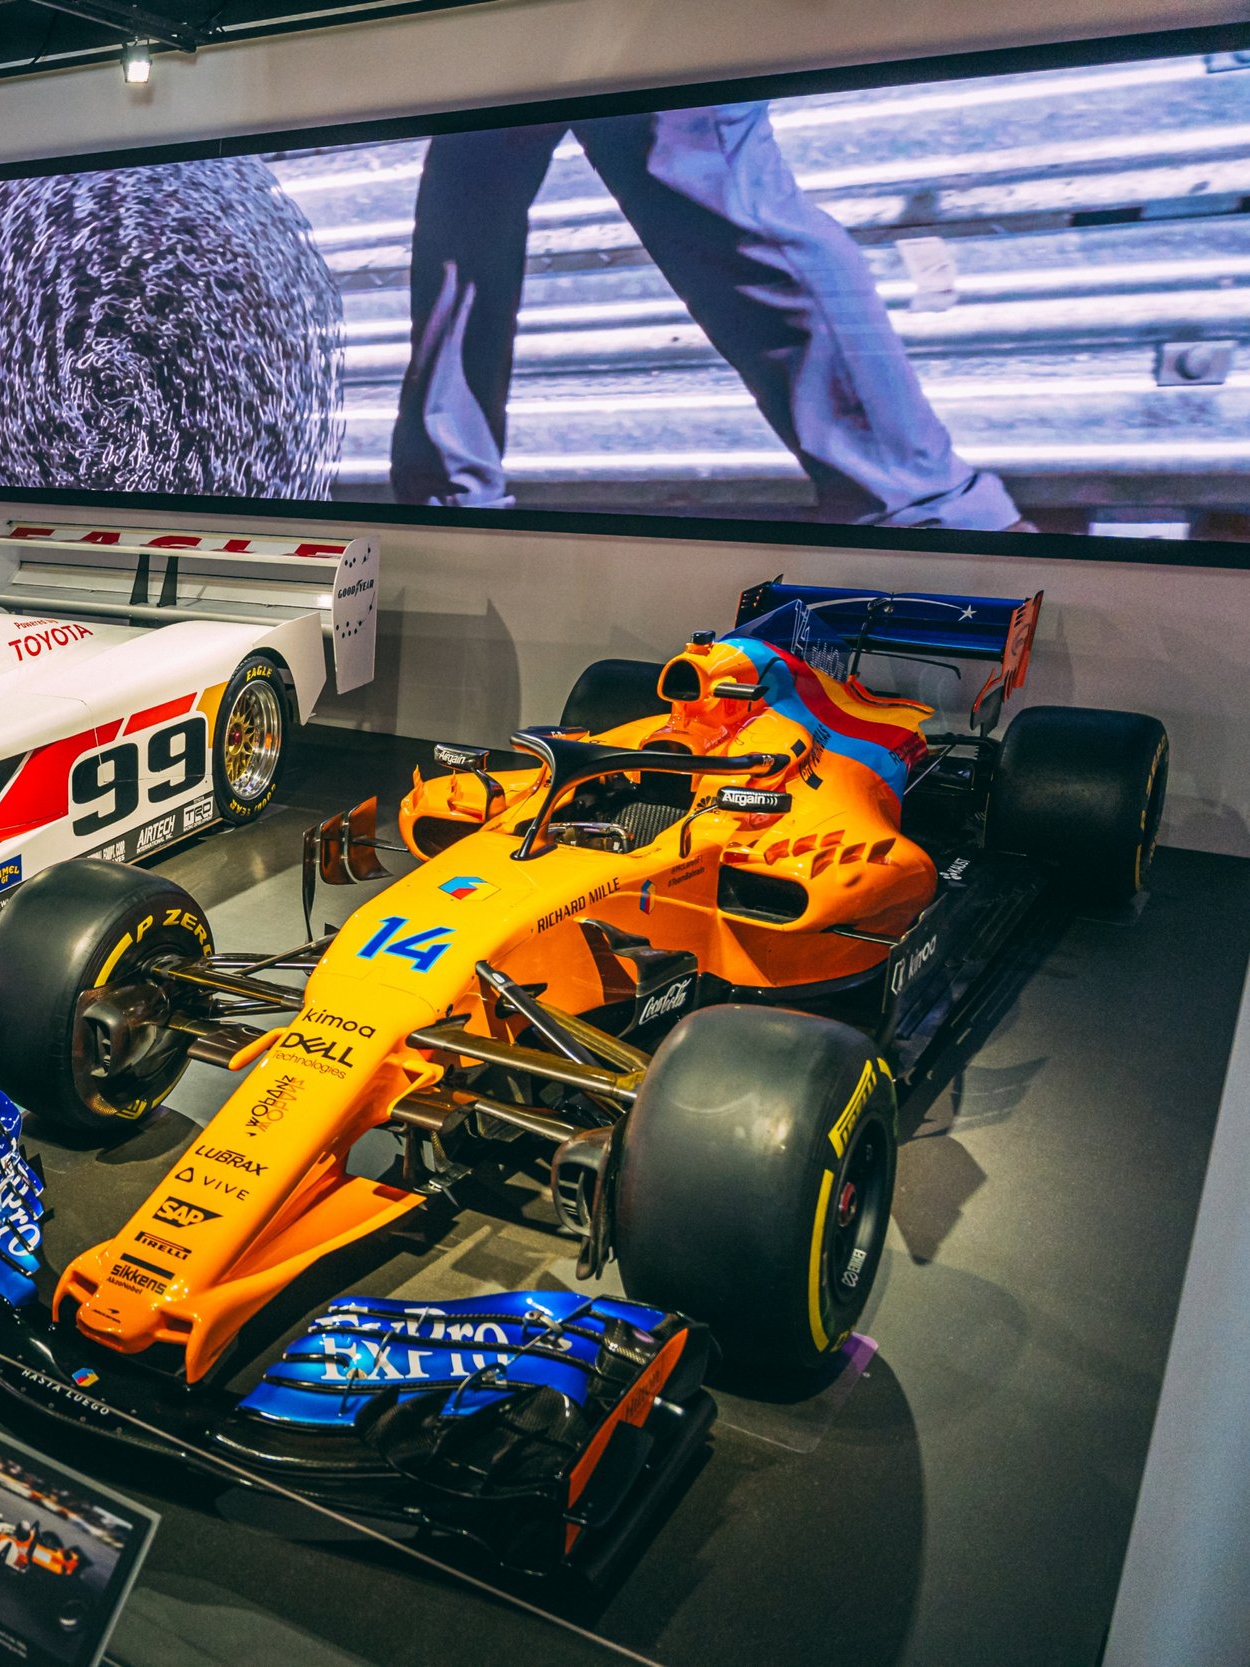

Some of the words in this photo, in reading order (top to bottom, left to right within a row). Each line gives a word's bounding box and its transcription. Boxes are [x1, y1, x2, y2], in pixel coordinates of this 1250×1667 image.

[14, 619, 47, 629] Powered
[8, 624, 94, 661] TOYOTA
[246, 665, 273, 682] EAGLE
[439, 749, 467, 765] Airgain
[72, 717, 206, 836] 99
[184, 802, 212, 824] TRD
[722, 791, 766, 806] Airgain
[136, 814, 176, 849] AIRTECH
[537, 894, 587, 933] RICHARD
[588, 877, 621, 908] MILLE
[136, 915, 154, 944] P
[356, 916, 457, 974] 14
[302, 1008, 376, 1039] kimoa
[273, 1050, 347, 1080] Technologies
[280, 1032, 353, 1068] DELL
[195, 1145, 269, 1177] LUBRAX
[204, 1175, 250, 1201] VIVE
[156, 1200, 206, 1226] SAP
[134, 1230, 192, 1260] PIRELLI
[106, 1276, 144, 1296] AkzoNobel
[110, 1264, 168, 1296] sikkens
[21, 1368, 62, 1393] HASTA
[65, 1390, 110, 1415] LUEGO
